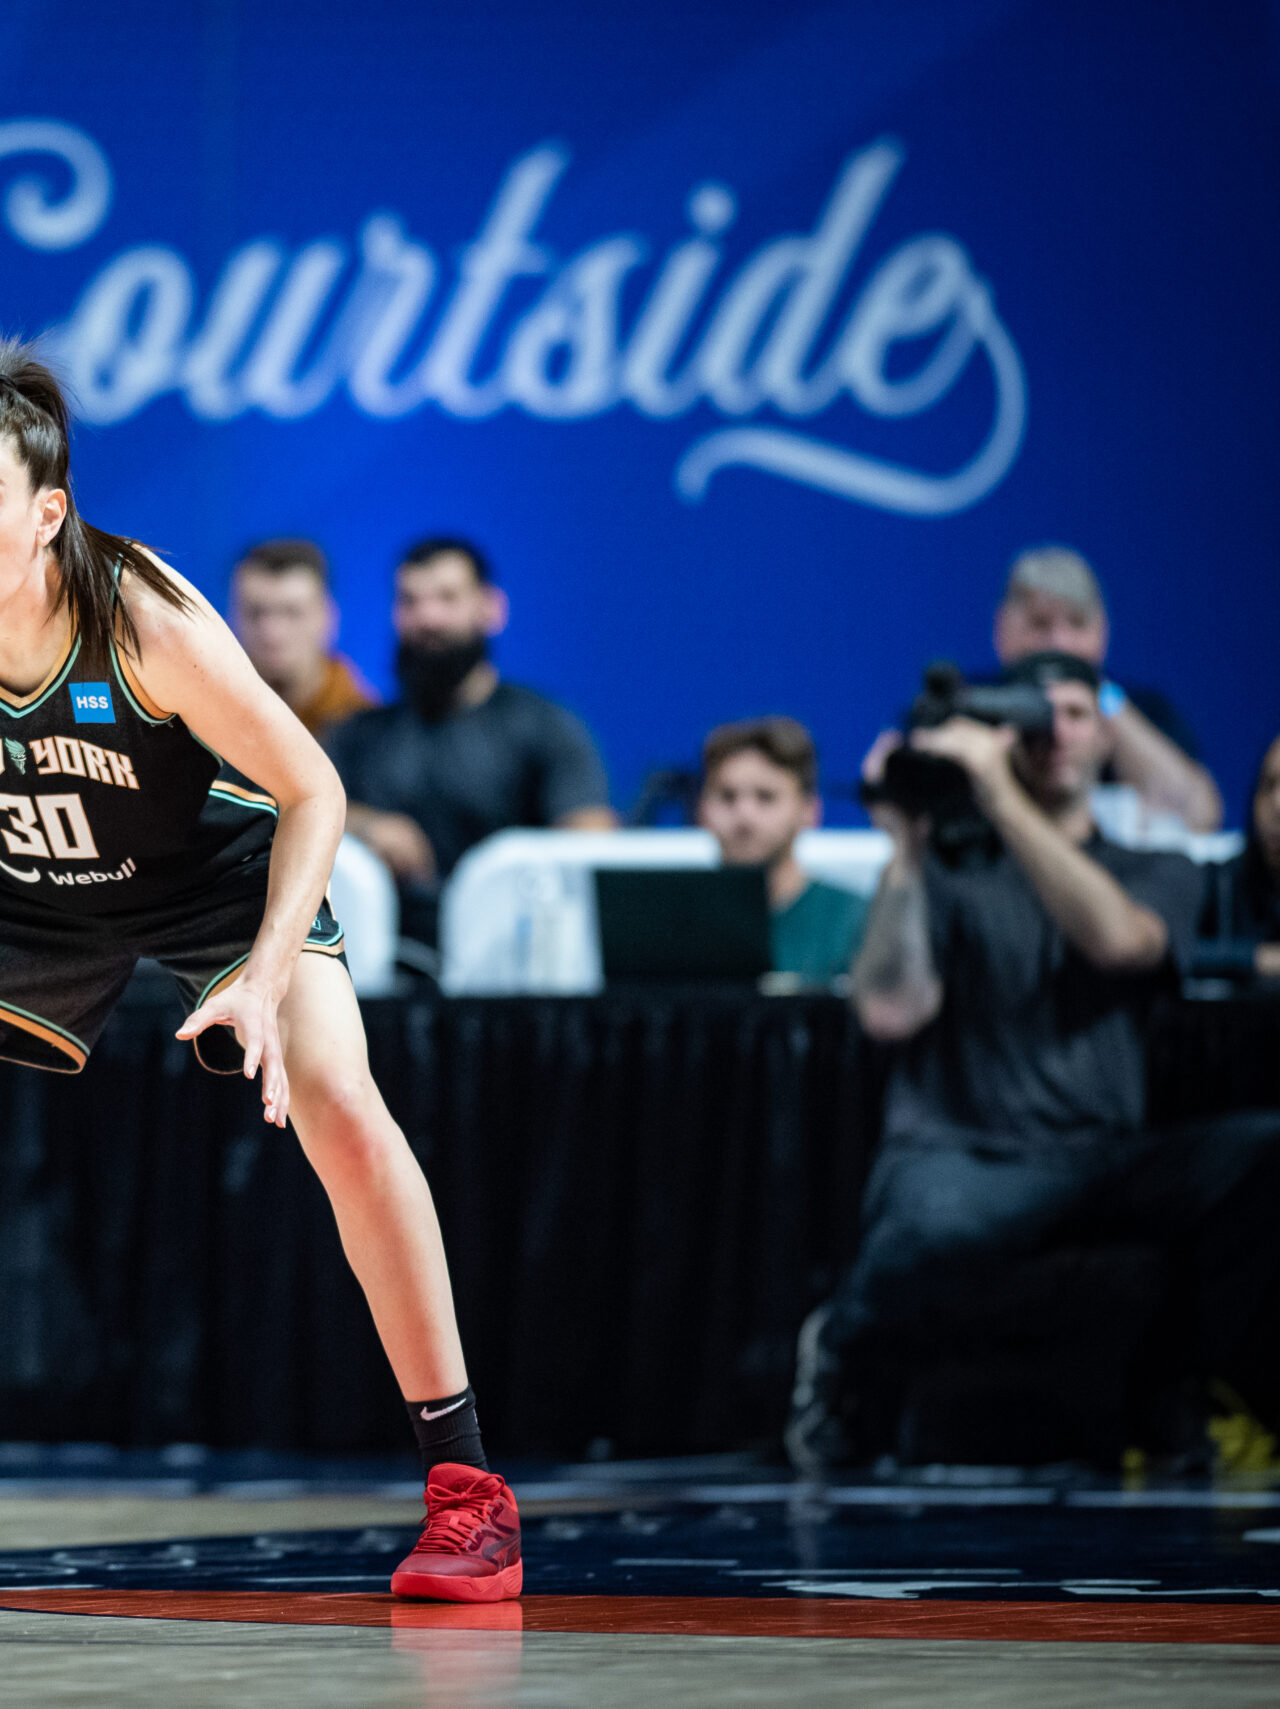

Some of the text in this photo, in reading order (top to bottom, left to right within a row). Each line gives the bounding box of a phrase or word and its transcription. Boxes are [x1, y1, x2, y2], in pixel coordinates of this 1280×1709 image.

[76, 696, 109, 709] HSS
[28, 735, 141, 790] YORK
[48, 857, 137, 885] Webull
